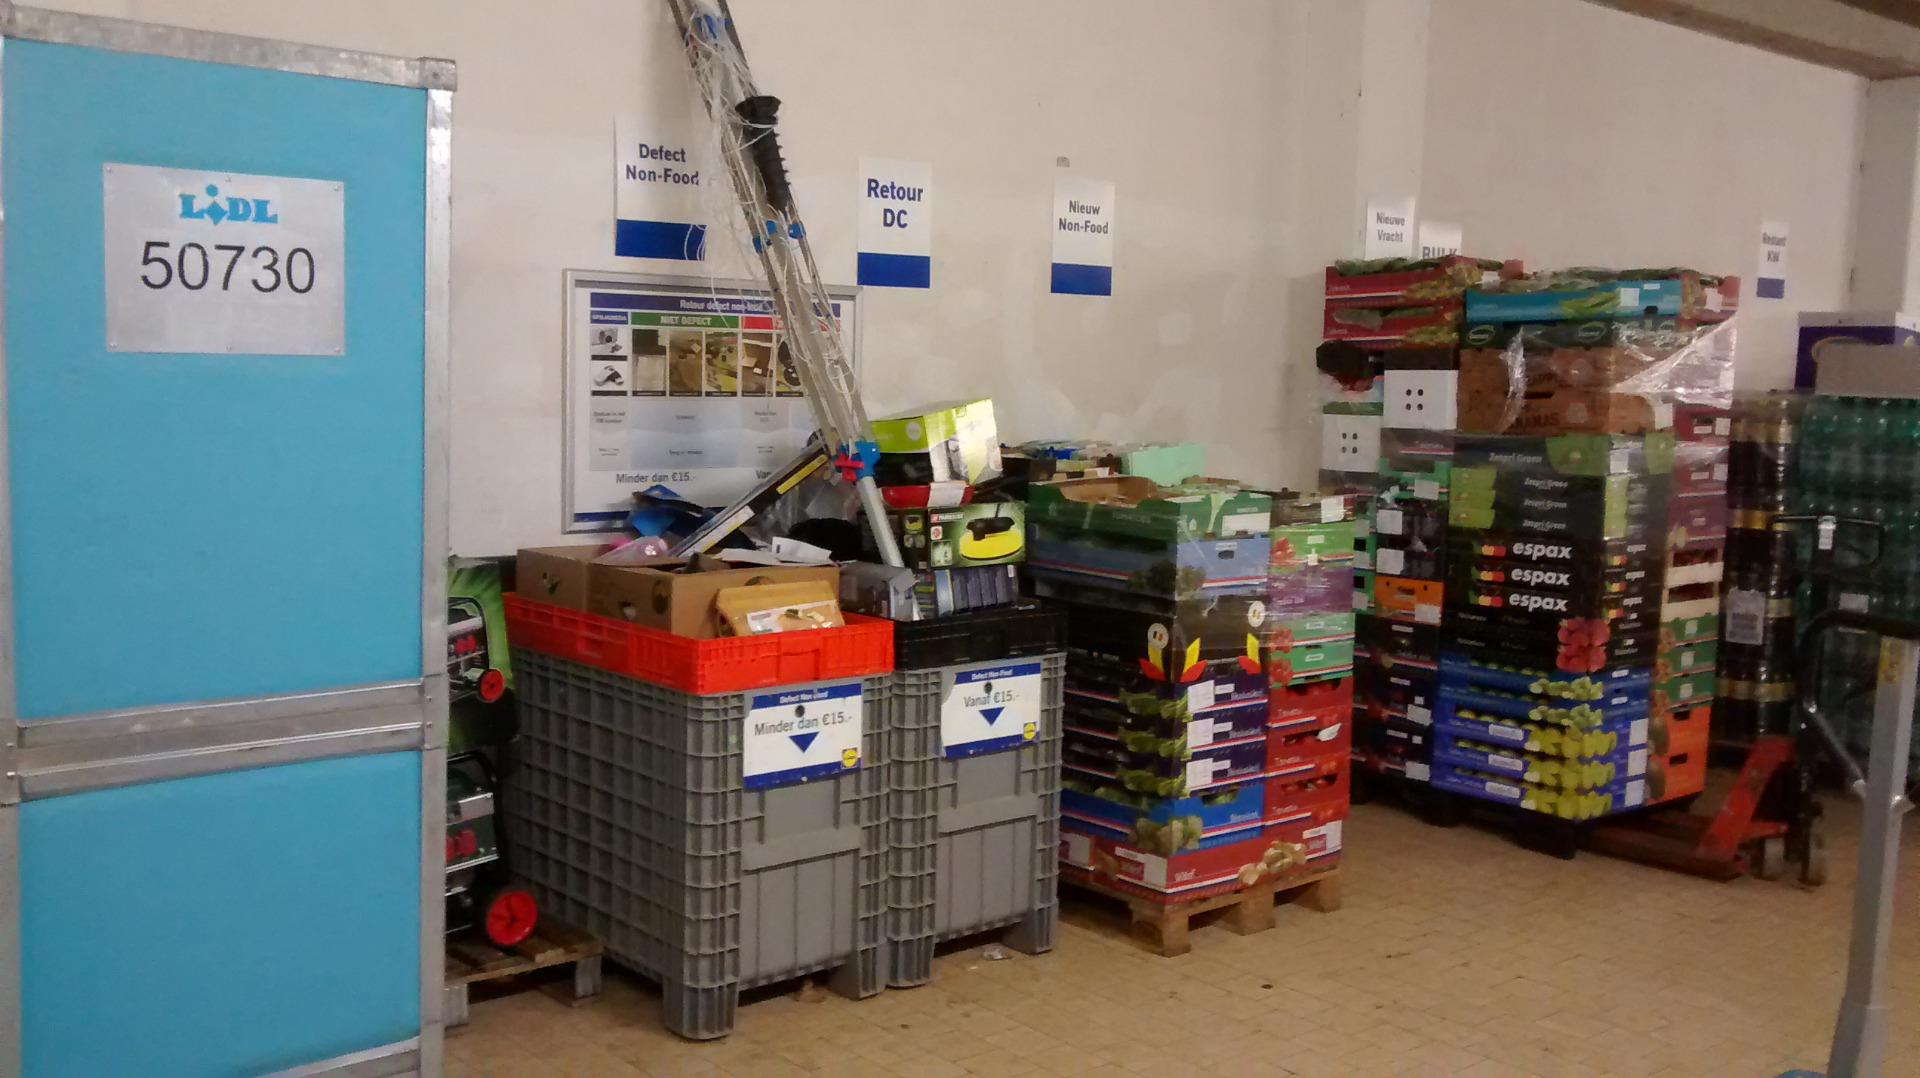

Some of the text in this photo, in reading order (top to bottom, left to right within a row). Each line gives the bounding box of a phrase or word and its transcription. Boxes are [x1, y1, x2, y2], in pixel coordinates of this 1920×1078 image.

[638, 143, 687, 163] Defect
[625, 165, 699, 186] Non-Food
[867, 178, 924, 202] Retour
[1068, 200, 1101, 215] Nieuw
[882, 208, 908, 229] DC
[1058, 218, 1109, 234] Non-Food
[1376, 212, 1405, 226] Nieuwe
[1377, 229, 1404, 243] Vracht
[141, 240, 315, 294] 50730
[680, 299, 705, 310] Retour
[706, 301, 730, 311] defect
[660, 315, 712, 326] NIET DEFECT
[615, 471, 697, 483] Minder dan €15.-
[1512, 542, 1573, 561] espax
[1511, 568, 1571, 587] espax
[1508, 593, 1569, 613] espax
[963, 690, 1020, 708] Vanaf €15.-
[754, 712, 853, 736] Minder dan €15.-
